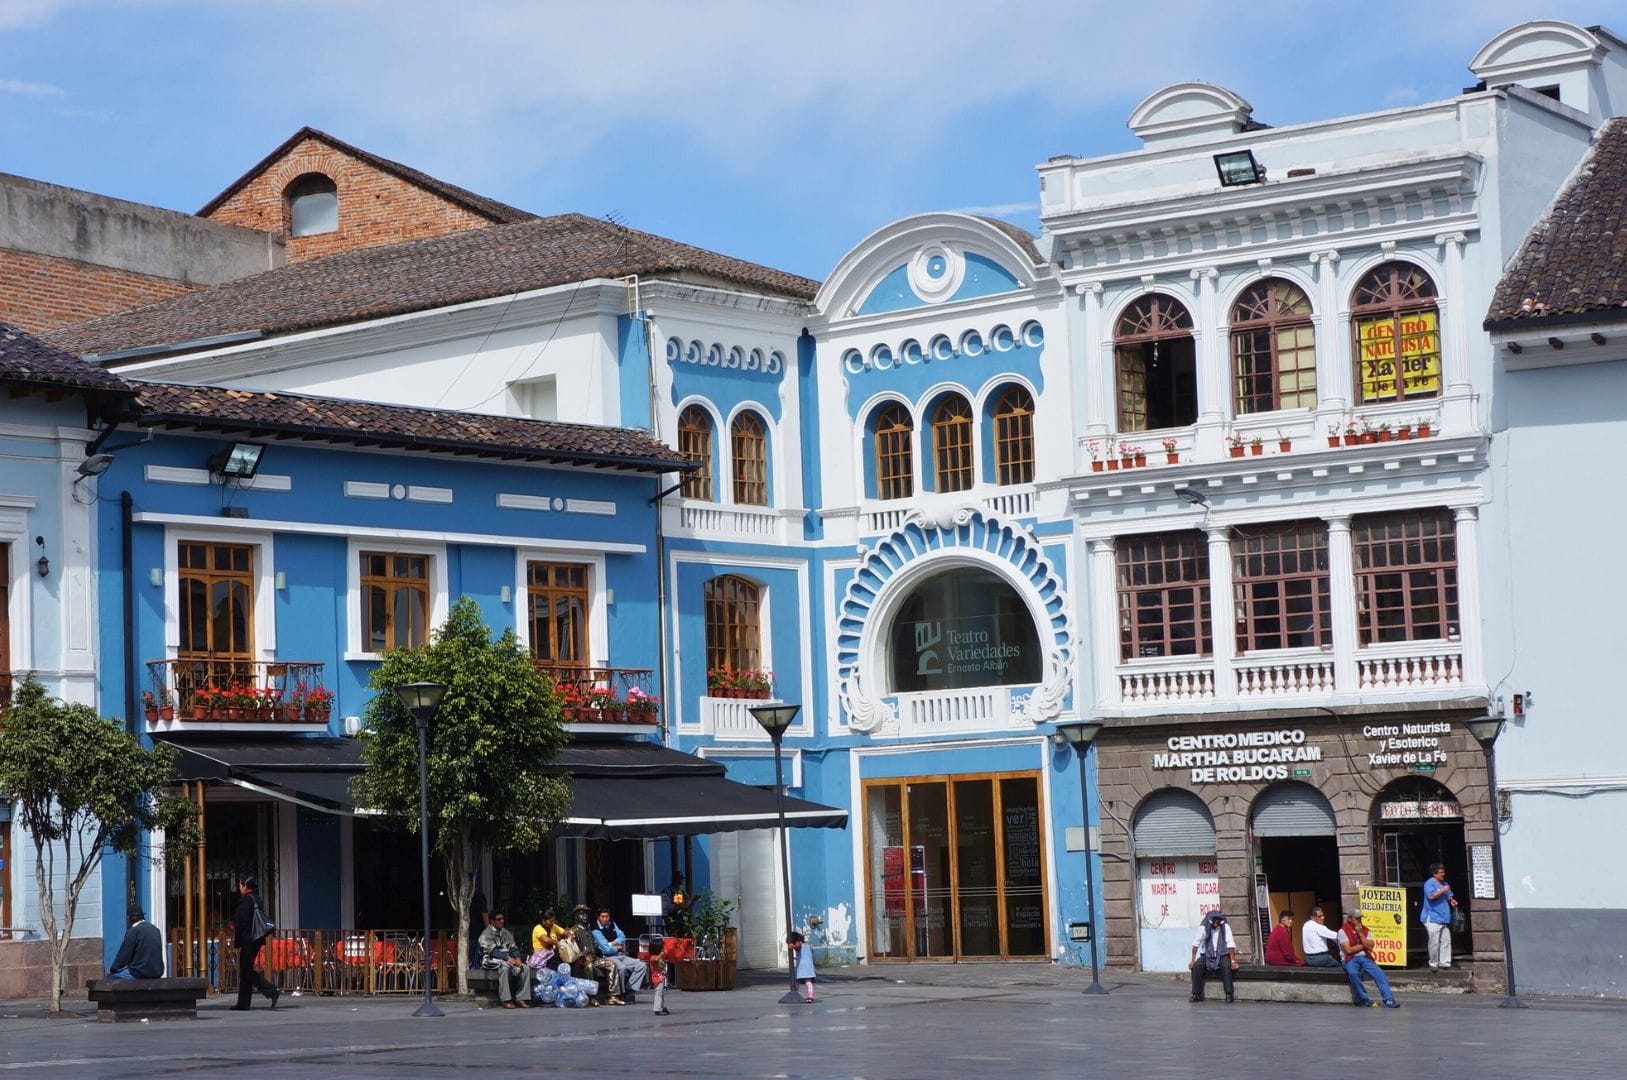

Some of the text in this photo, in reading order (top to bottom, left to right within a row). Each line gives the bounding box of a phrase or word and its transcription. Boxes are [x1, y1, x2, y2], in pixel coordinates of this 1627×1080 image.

[1367, 356, 1431, 378] Xaier
[946, 630, 988, 644] Teatro
[947, 642, 1020, 661] Variedades
[947, 662, 981, 673] Ernesto
[1363, 722, 1451, 737] Centro Naturista
[1167, 729, 1305, 750] CENTRO MEDICO
[1380, 736, 1438, 752] y Esoterico
[1153, 746, 1321, 768] MARTHA BUCARAM
[1368, 752, 1401, 765] Xavier
[1403, 751, 1416, 763] de
[1418, 751, 1432, 763] La
[1191, 768, 1214, 783] DE
[1217, 765, 1288, 782] ROLDOS
[1006, 815, 1024, 825] ver
[1150, 863, 1176, 875] CENTRO
[1151, 883, 1177, 896] MARTHA
[1361, 889, 1402, 901] JOYERIA
[1161, 904, 1169, 917] DE
[1361, 903, 1402, 912] RELOJERIA
